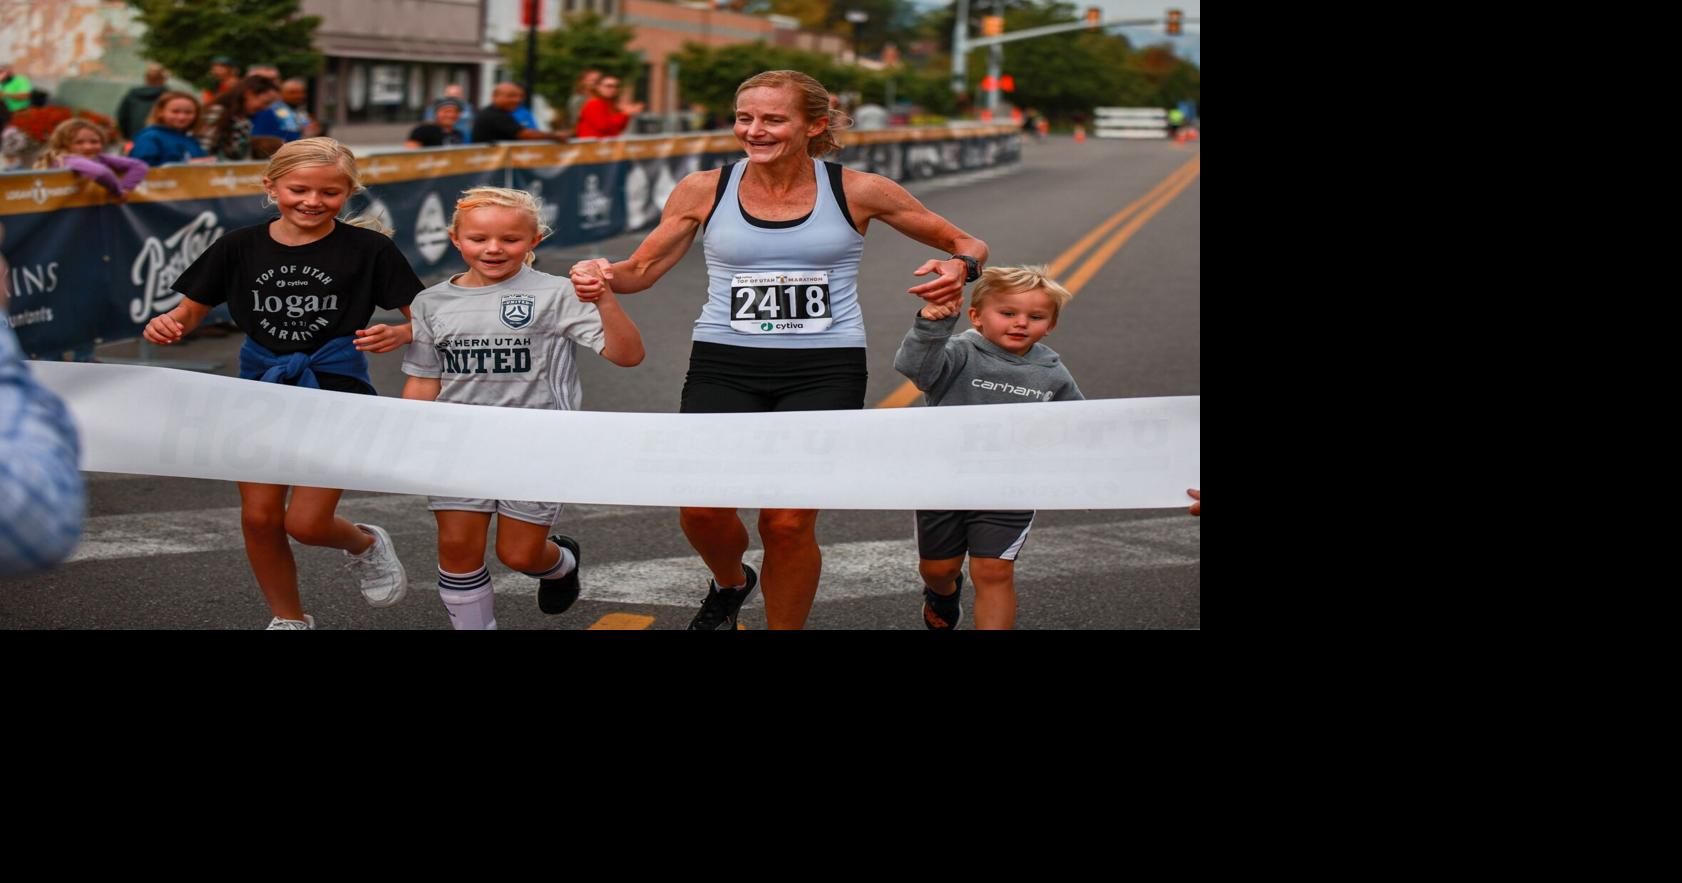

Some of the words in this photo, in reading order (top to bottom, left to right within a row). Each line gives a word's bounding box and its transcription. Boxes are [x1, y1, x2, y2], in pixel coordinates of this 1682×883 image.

[256, 269, 275, 285] TOP
[280, 265, 297, 274] OF
[302, 266, 333, 285] UTAH
[251, 290, 339, 318] Logan
[735, 285, 826, 319] 2418
[775, 322, 804, 330] cytiva
[495, 338, 531, 346] UTAH
[971, 379, 1043, 400] carhart
